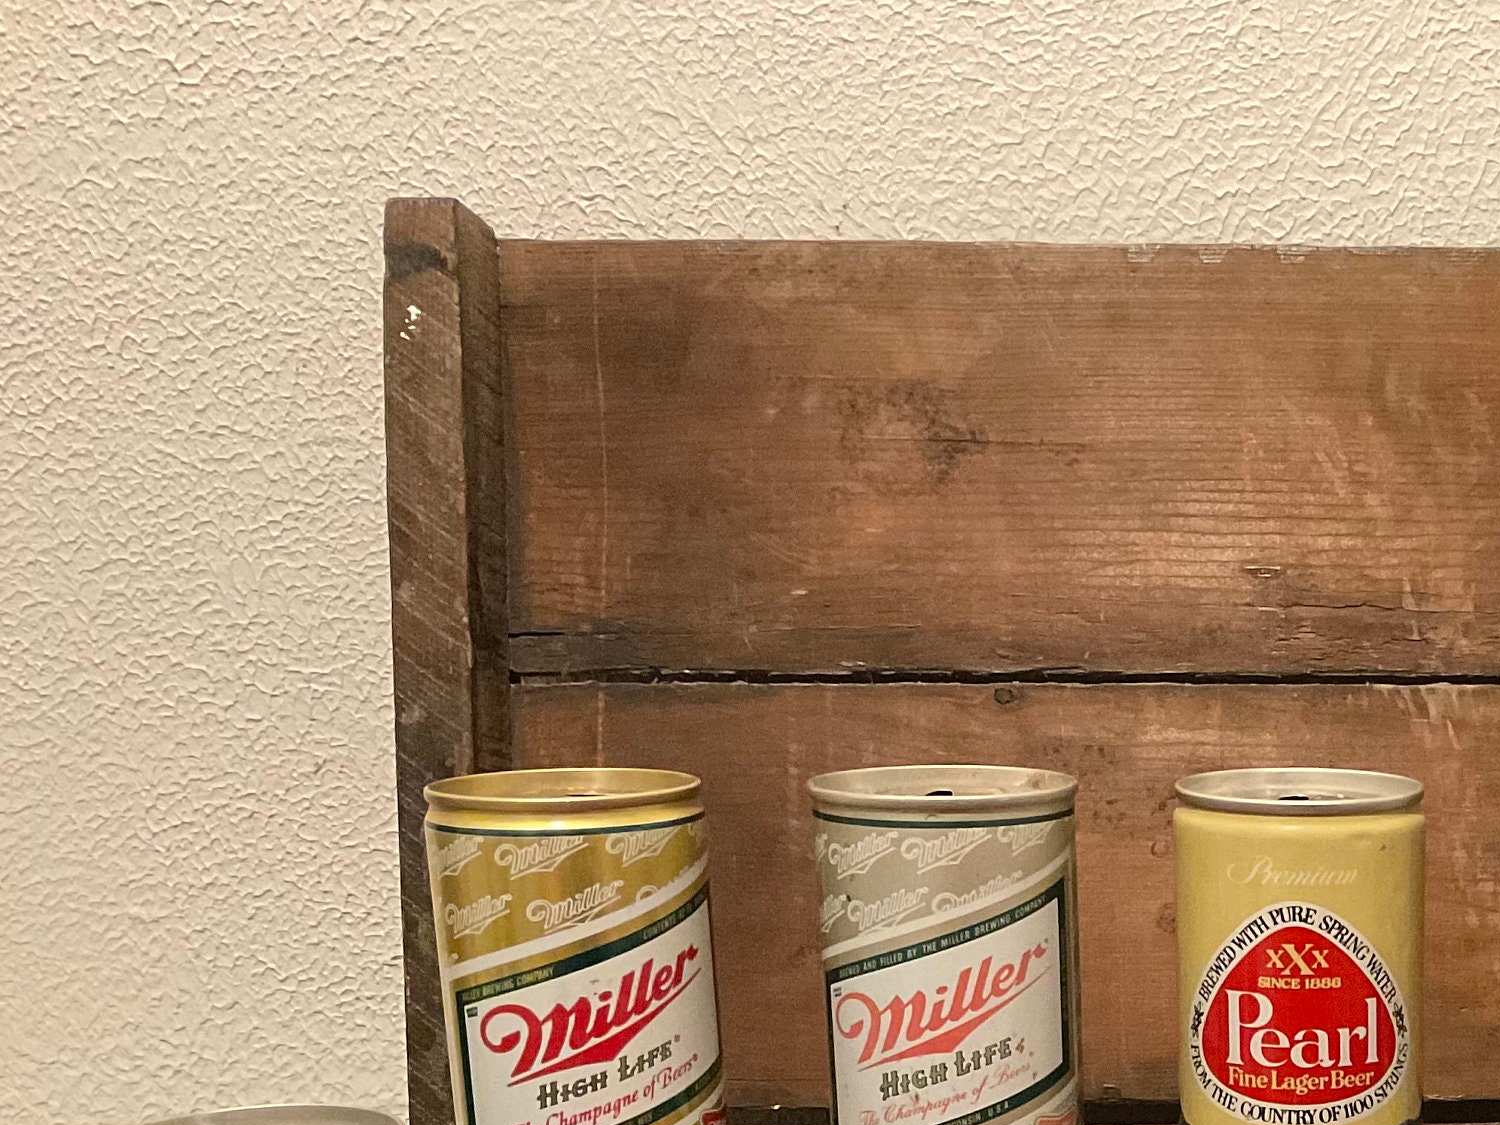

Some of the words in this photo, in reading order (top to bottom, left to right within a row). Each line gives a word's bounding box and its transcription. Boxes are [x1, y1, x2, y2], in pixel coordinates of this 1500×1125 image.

[829, 831, 899, 880] Miller
[1227, 853, 1358, 886] Premium
[526, 880, 624, 935] Miller
[847, 886, 930, 933] Miller
[863, 958, 878, 973] AND
[922, 941, 937, 954] THE
[940, 930, 971, 949] MILLER
[974, 914, 1012, 937] BREWING
[1014, 896, 1047, 918] COMPANY
[516, 966, 556, 986] COMPANY
[1198, 945, 1237, 1002] BREWED
[1231, 916, 1271, 951] WITH
[1267, 905, 1318, 926] PURE
[1318, 914, 1370, 962] SPRING
[1365, 953, 1398, 1006] WATER
[1257, 976, 1301, 989] SINCE
[480, 943, 701, 1087] Miller
[836, 938, 1052, 1071] Miller
[1225, 989, 1380, 1069] Pearl
[537, 1070, 609, 1109] HIGH
[643, 1080, 656, 1101] of
[879, 1062, 949, 1102] HIGH
[954, 1036, 1013, 1077] LIFE
[884, 1091, 968, 1124] Champagne
[971, 1076, 988, 1104] of
[990, 1062, 1032, 1090] Beers
[1190, 1043, 1215, 1090] FROM
[1211, 1084, 1238, 1112] THE
[1240, 1101, 1318, 1125] COUNTRY
[1318, 1104, 1346, 1124] OF
[1345, 1094, 1374, 1119] 1100
[1373, 1042, 1409, 1104] SPRINGS
[1228, 1065, 1269, 1090] Fine
[1271, 1070, 1329, 1095] Lager
[1331, 1069, 1375, 1090] Beer
